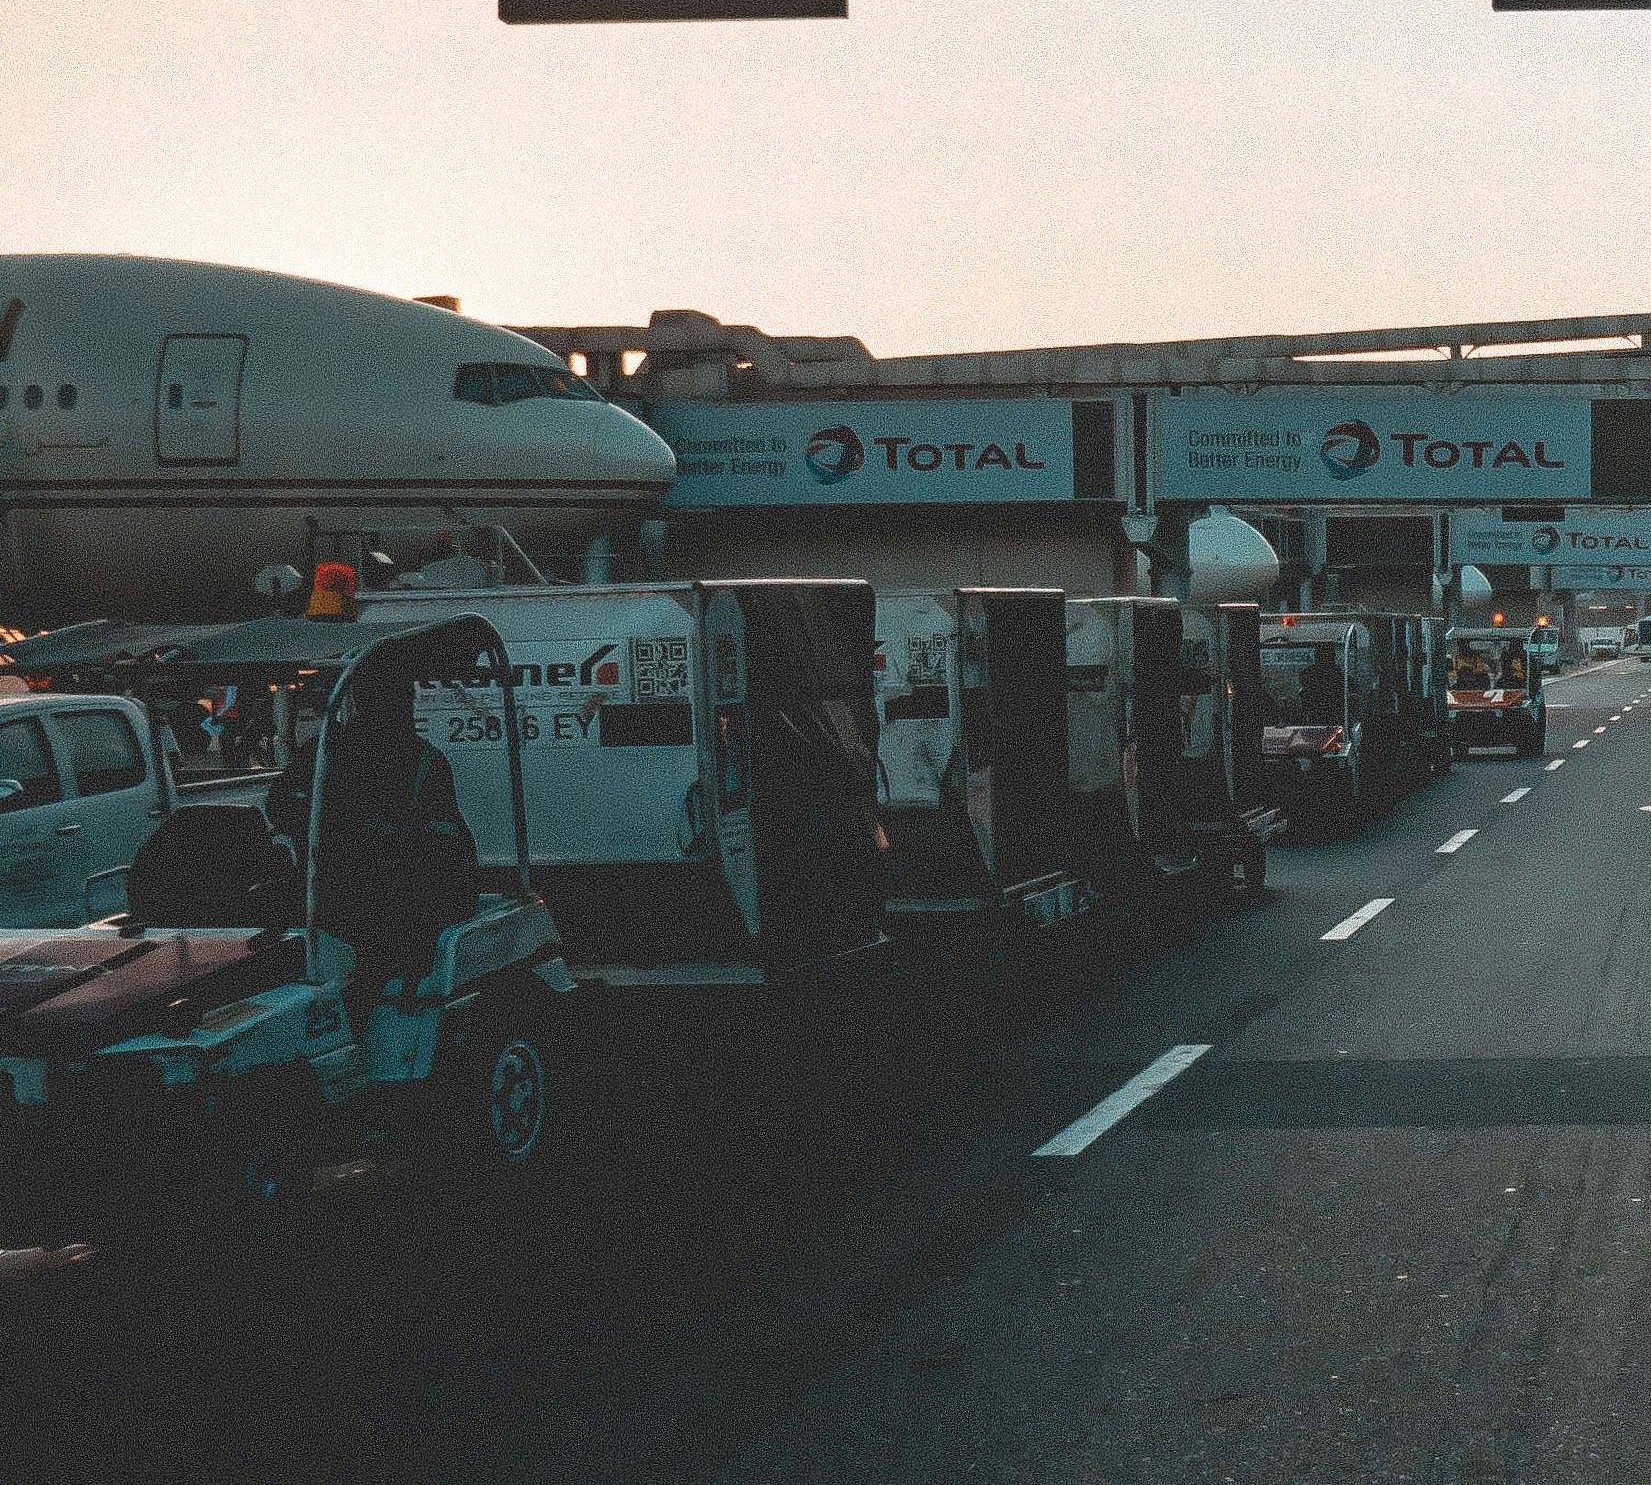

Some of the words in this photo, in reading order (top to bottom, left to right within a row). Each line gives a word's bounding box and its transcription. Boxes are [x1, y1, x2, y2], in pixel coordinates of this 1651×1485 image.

[676, 436, 766, 455] Committed
[773, 436, 788, 454] to
[1188, 430, 1279, 447] Committed
[1286, 430, 1301, 447] to
[873, 437, 1045, 472] TOTAL
[1390, 433, 1565, 469] TOTAL
[731, 458, 788, 478] Energy
[1188, 452, 1239, 469] Better
[1245, 452, 1301, 472] Energy
[1566, 531, 1649, 550] TOTAL
[448, 715, 541, 743] 2586
[554, 712, 598, 740] EY
